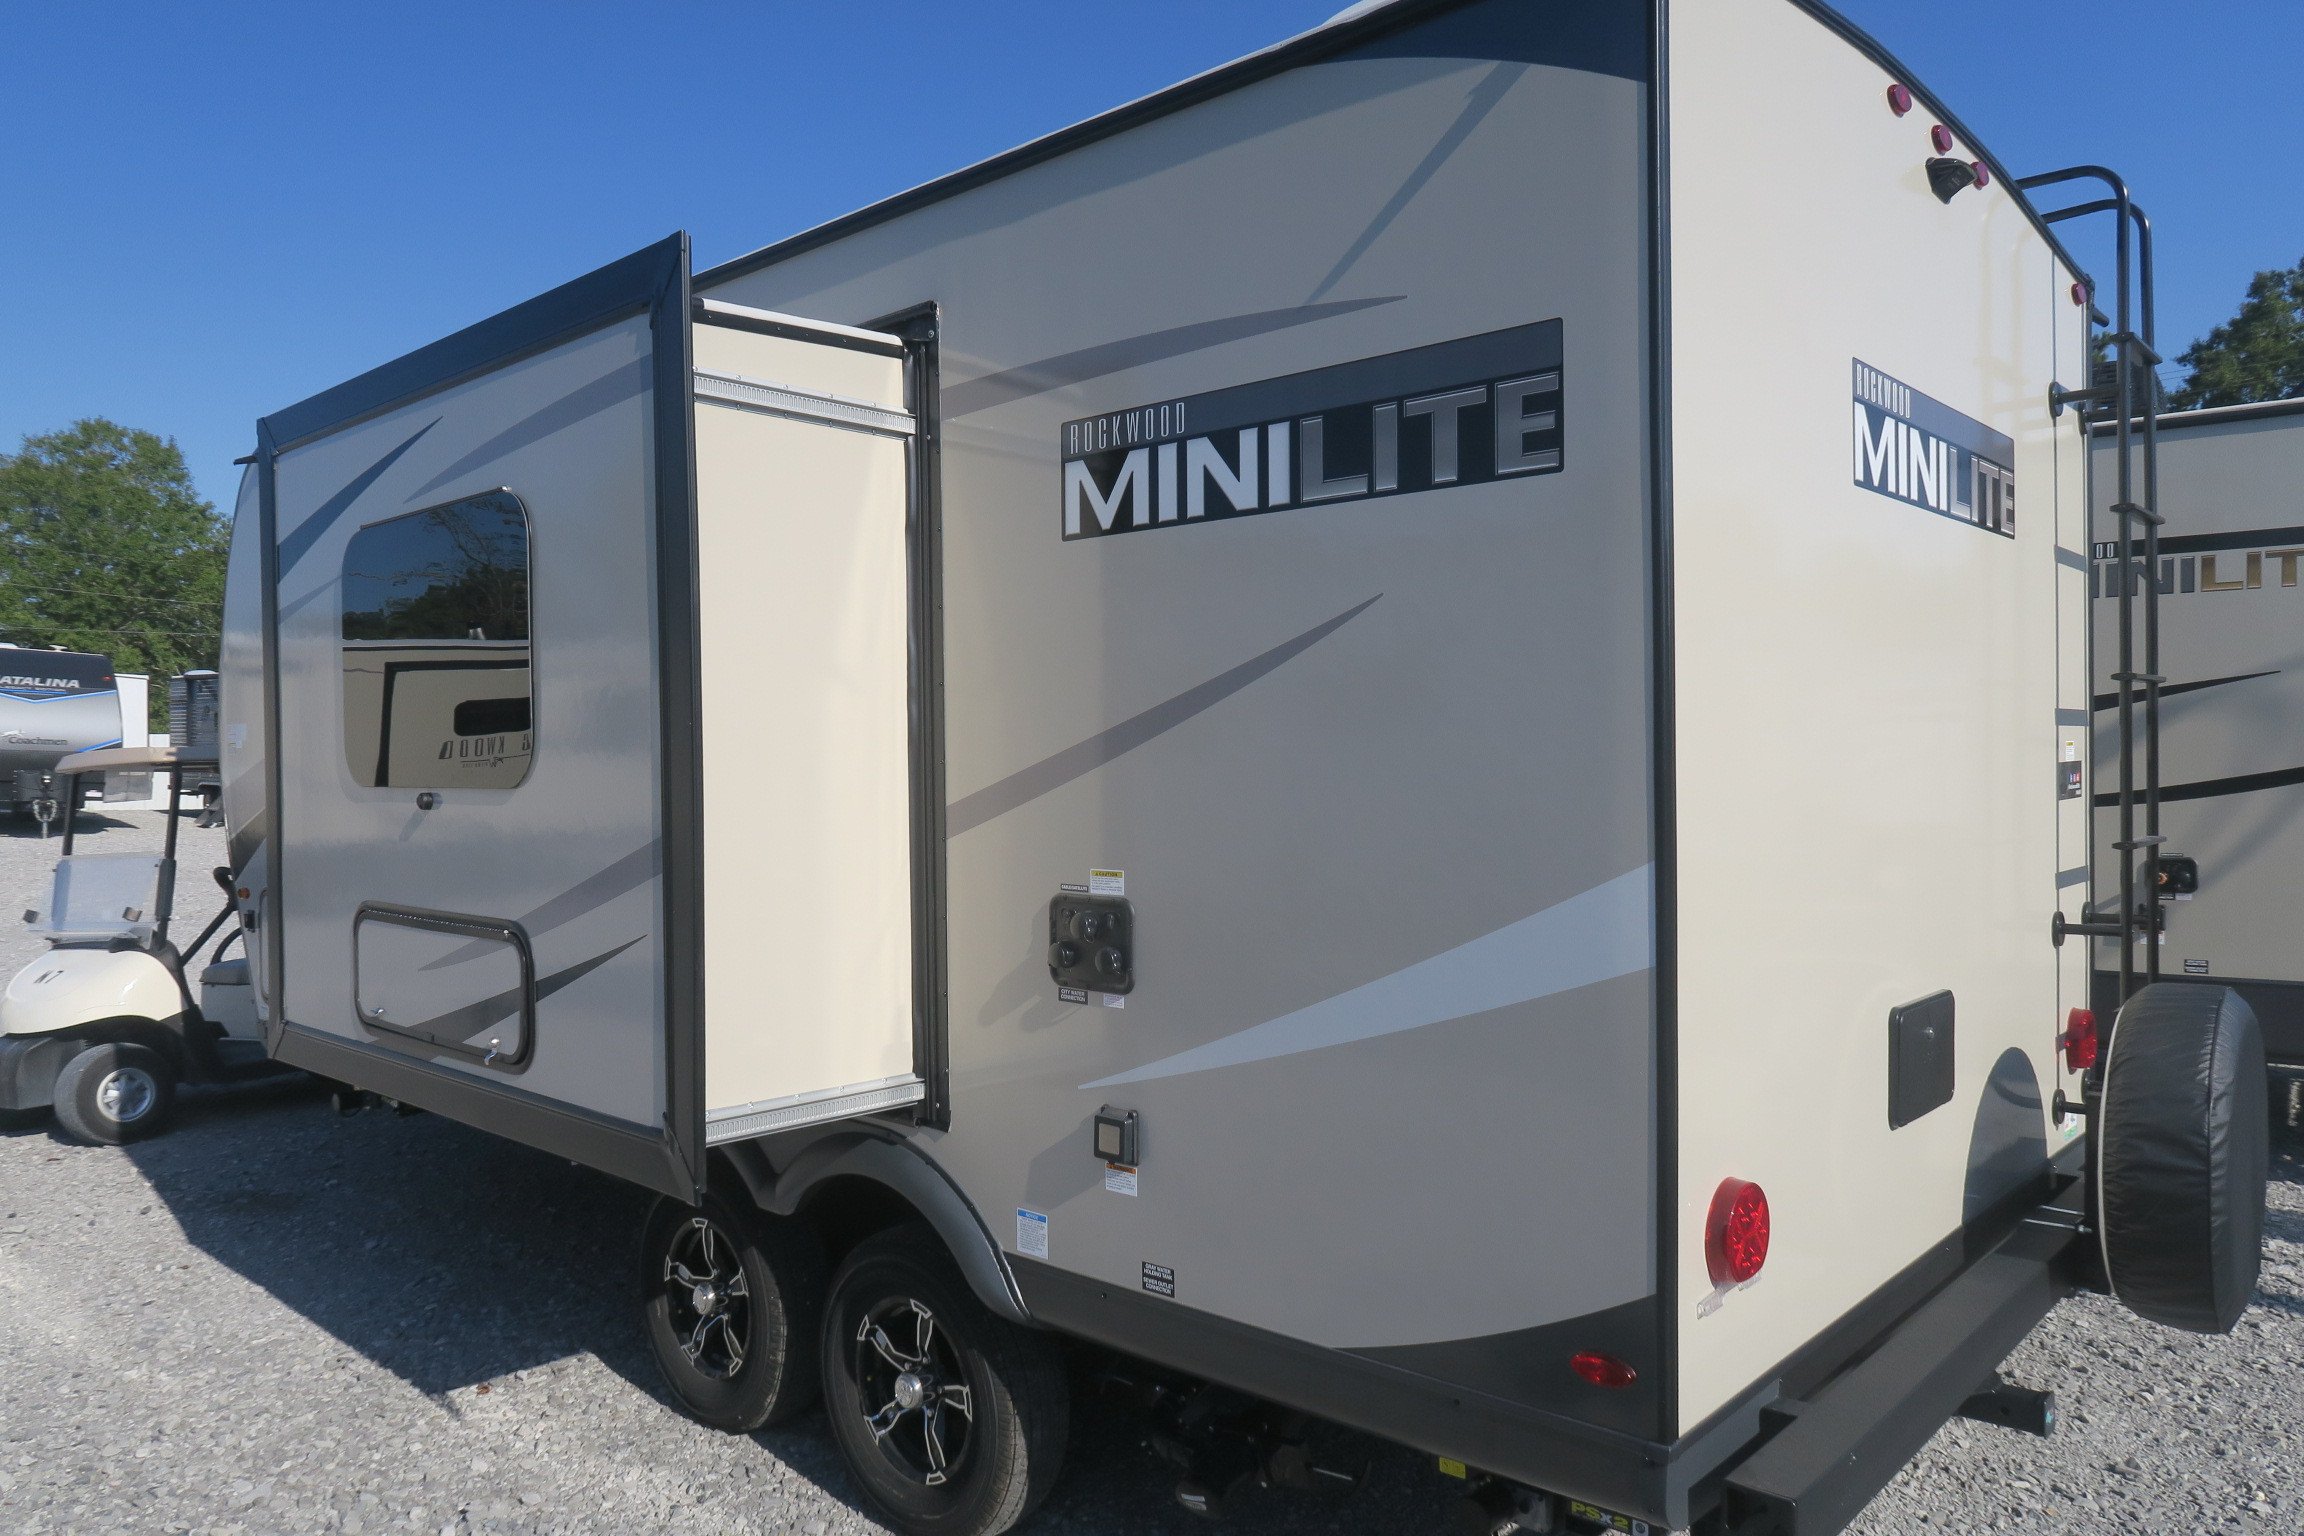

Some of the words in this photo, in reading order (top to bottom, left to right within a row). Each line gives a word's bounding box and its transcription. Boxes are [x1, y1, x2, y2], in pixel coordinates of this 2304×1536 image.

[1857, 363, 1911, 419] ROCKWOOD
[1070, 401, 1187, 455] ROCKWOOD
[2093, 547, 2304, 599] INILIT
[0, 675, 80, 688] ATALINA
